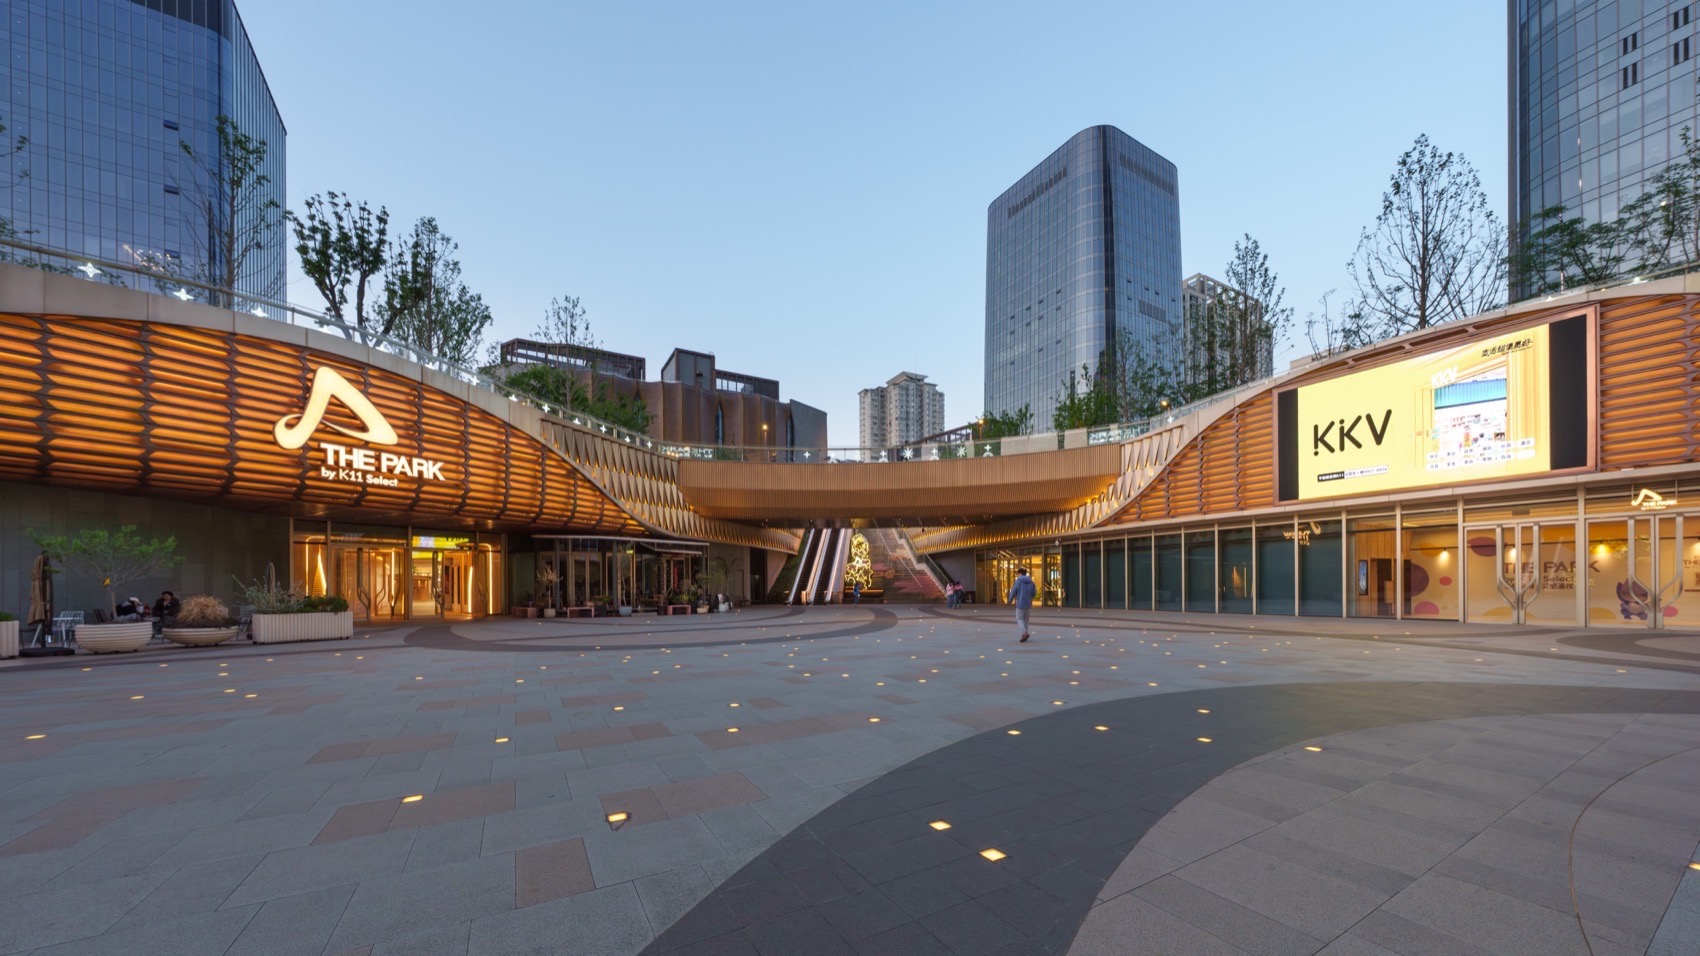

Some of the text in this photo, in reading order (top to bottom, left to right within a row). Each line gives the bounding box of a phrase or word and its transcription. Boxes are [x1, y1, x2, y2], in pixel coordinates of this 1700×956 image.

[320, 442, 446, 481] THE PARK
[321, 467, 399, 487] by K11 Select
